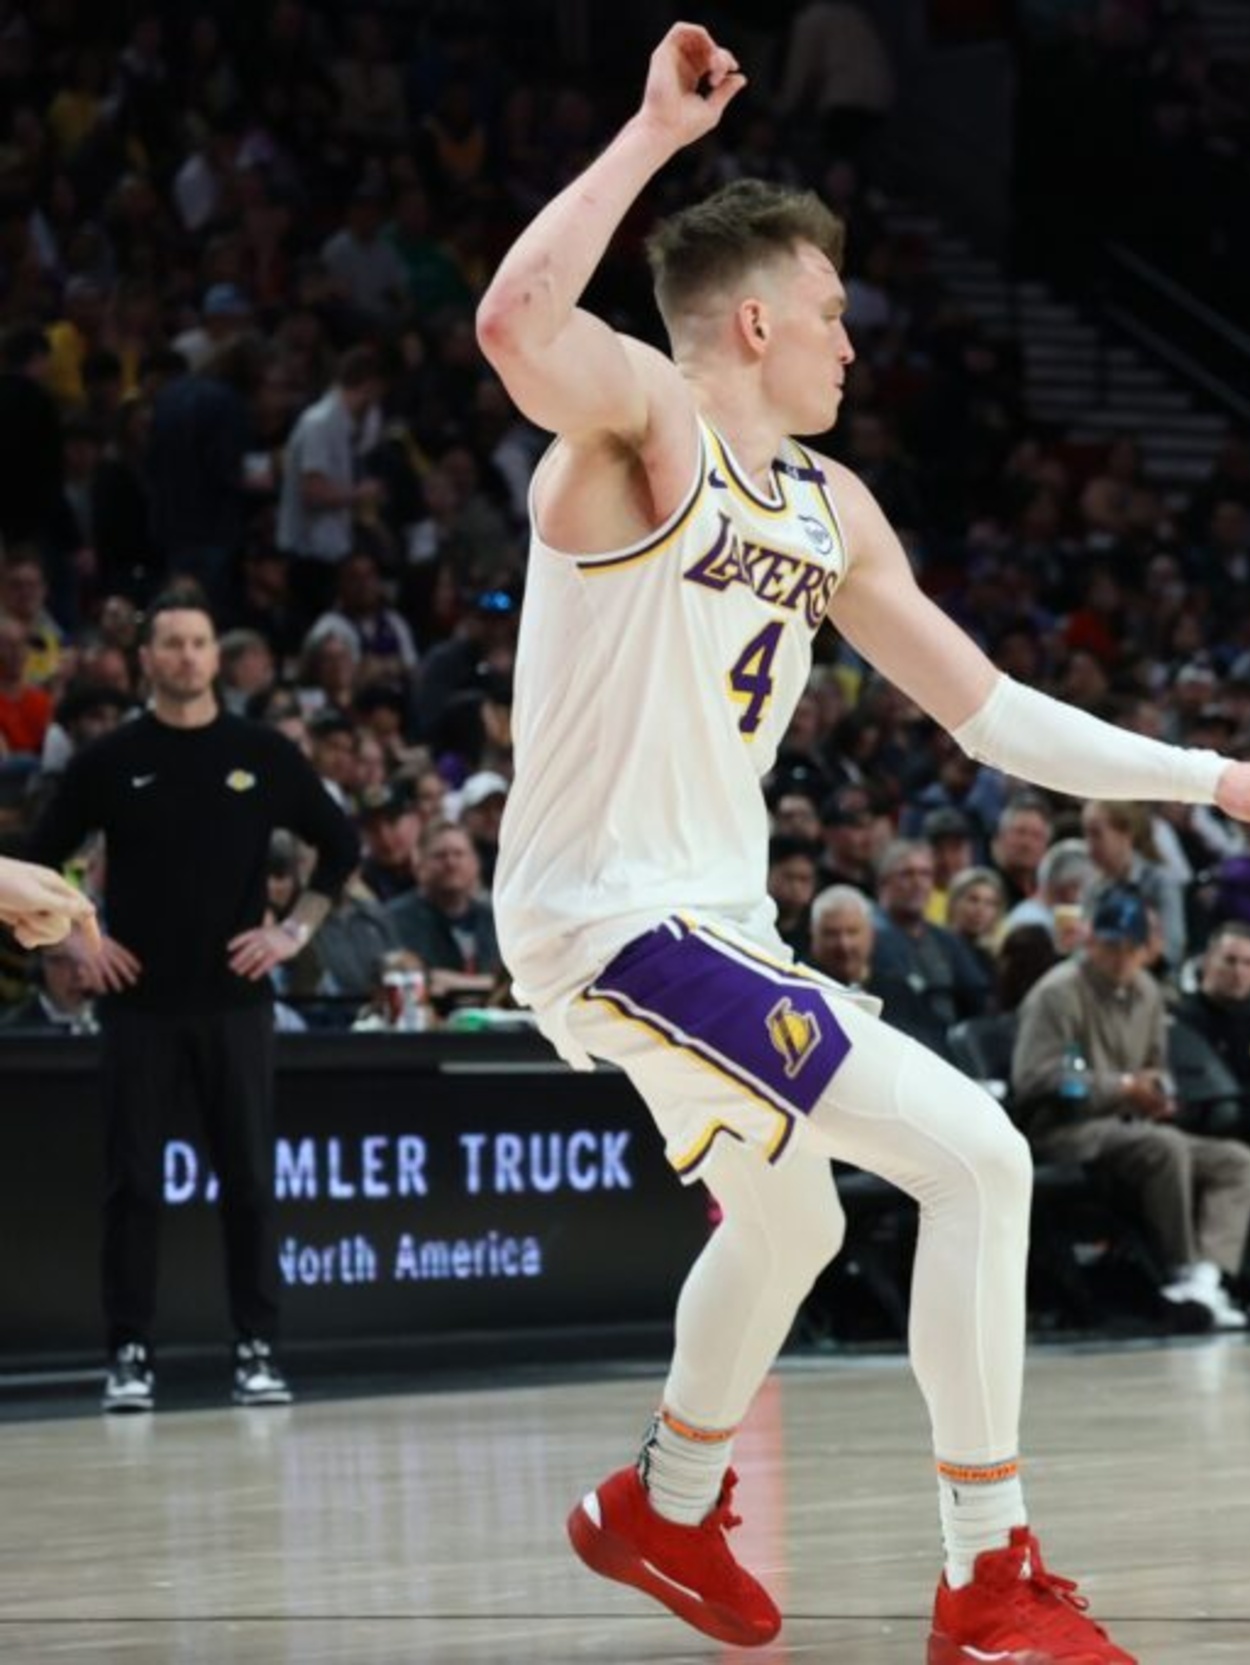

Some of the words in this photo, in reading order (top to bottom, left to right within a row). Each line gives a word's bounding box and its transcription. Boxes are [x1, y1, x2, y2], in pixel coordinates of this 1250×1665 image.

[683, 511, 840, 629] LAKERS
[726, 619, 786, 742] 4
[163, 1134, 429, 1203] DMLER
[459, 1129, 634, 1193] TRUCK
[394, 1229, 543, 1282] America
